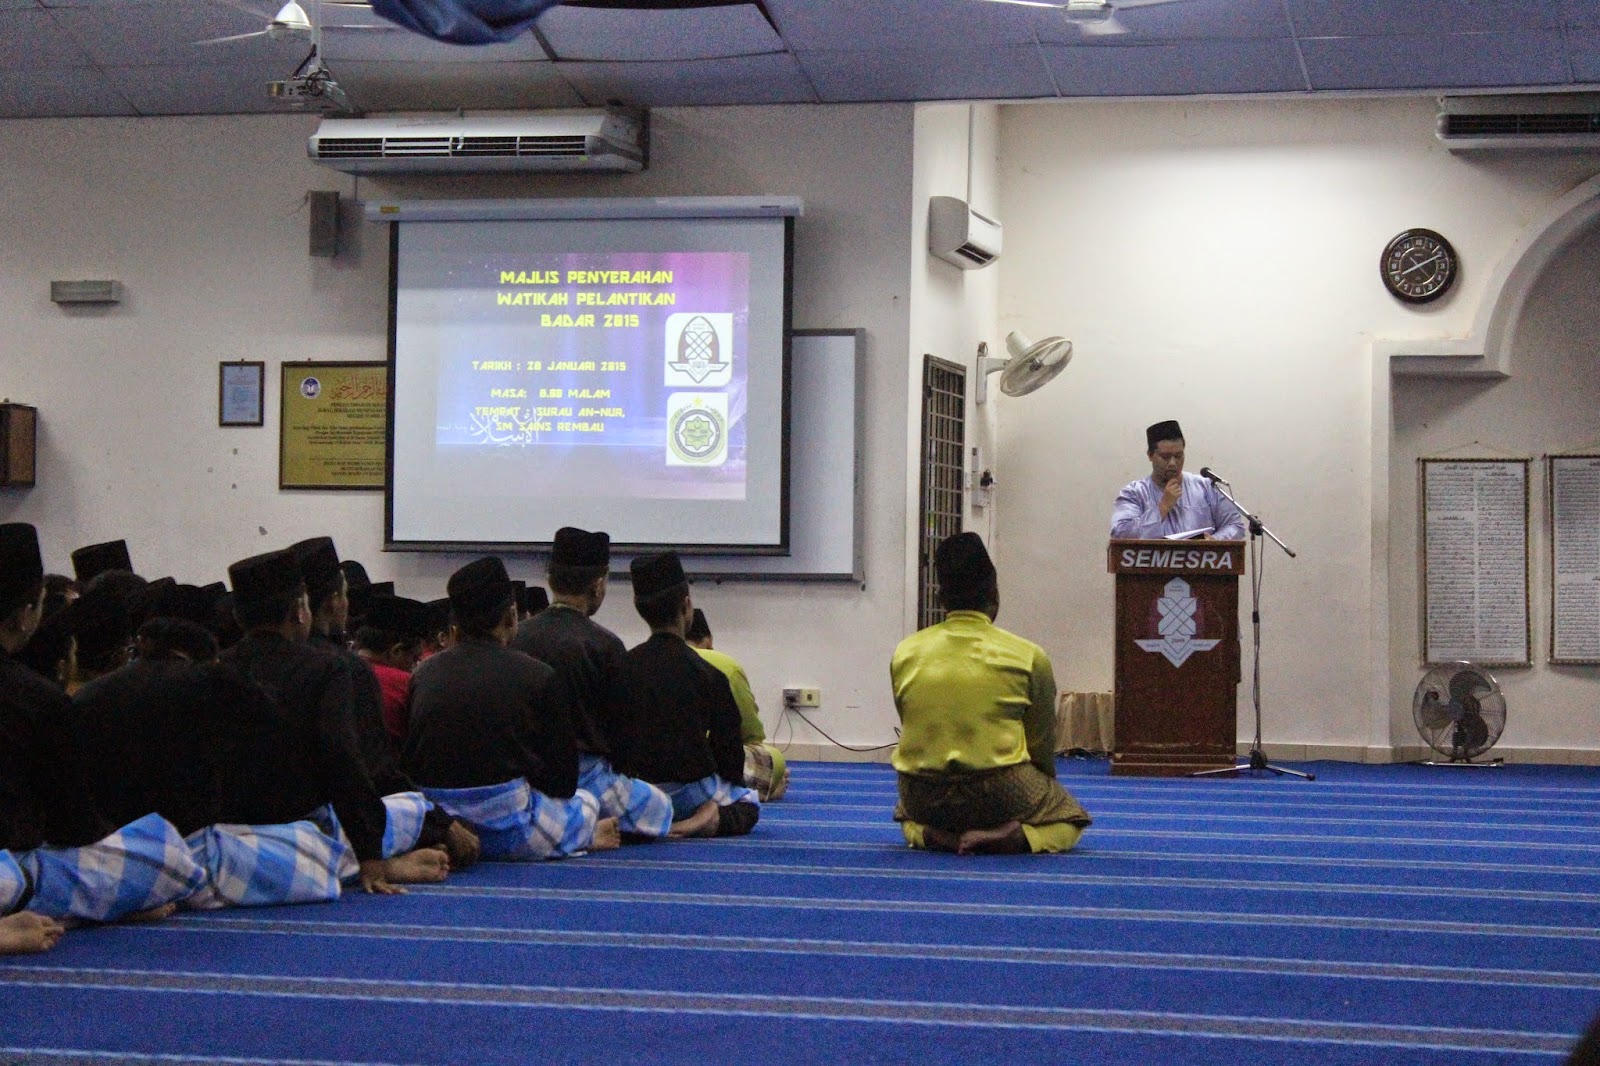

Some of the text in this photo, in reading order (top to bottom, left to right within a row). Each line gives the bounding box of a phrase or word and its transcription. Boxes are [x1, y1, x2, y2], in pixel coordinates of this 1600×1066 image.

[500, 270, 673, 284] MAJLIS PENYERAHAN
[497, 292, 676, 305] WATIKAH PELANTIKAN
[540, 314, 640, 327] BADAR 2015
[472, 361, 512, 371] TARIKH
[547, 361, 596, 371] JANUARI
[600, 361, 627, 371] 2015
[490, 388, 527, 398] MASA:
[568, 389, 611, 398] MALAM
[475, 406, 521, 417] TEMPAT
[536, 407, 573, 417] SURAU
[578, 407, 626, 418] AN-NUR,
[496, 422, 605, 432] SM SAINS REMBAU
[1120, 549, 1233, 570] SEMESRA
